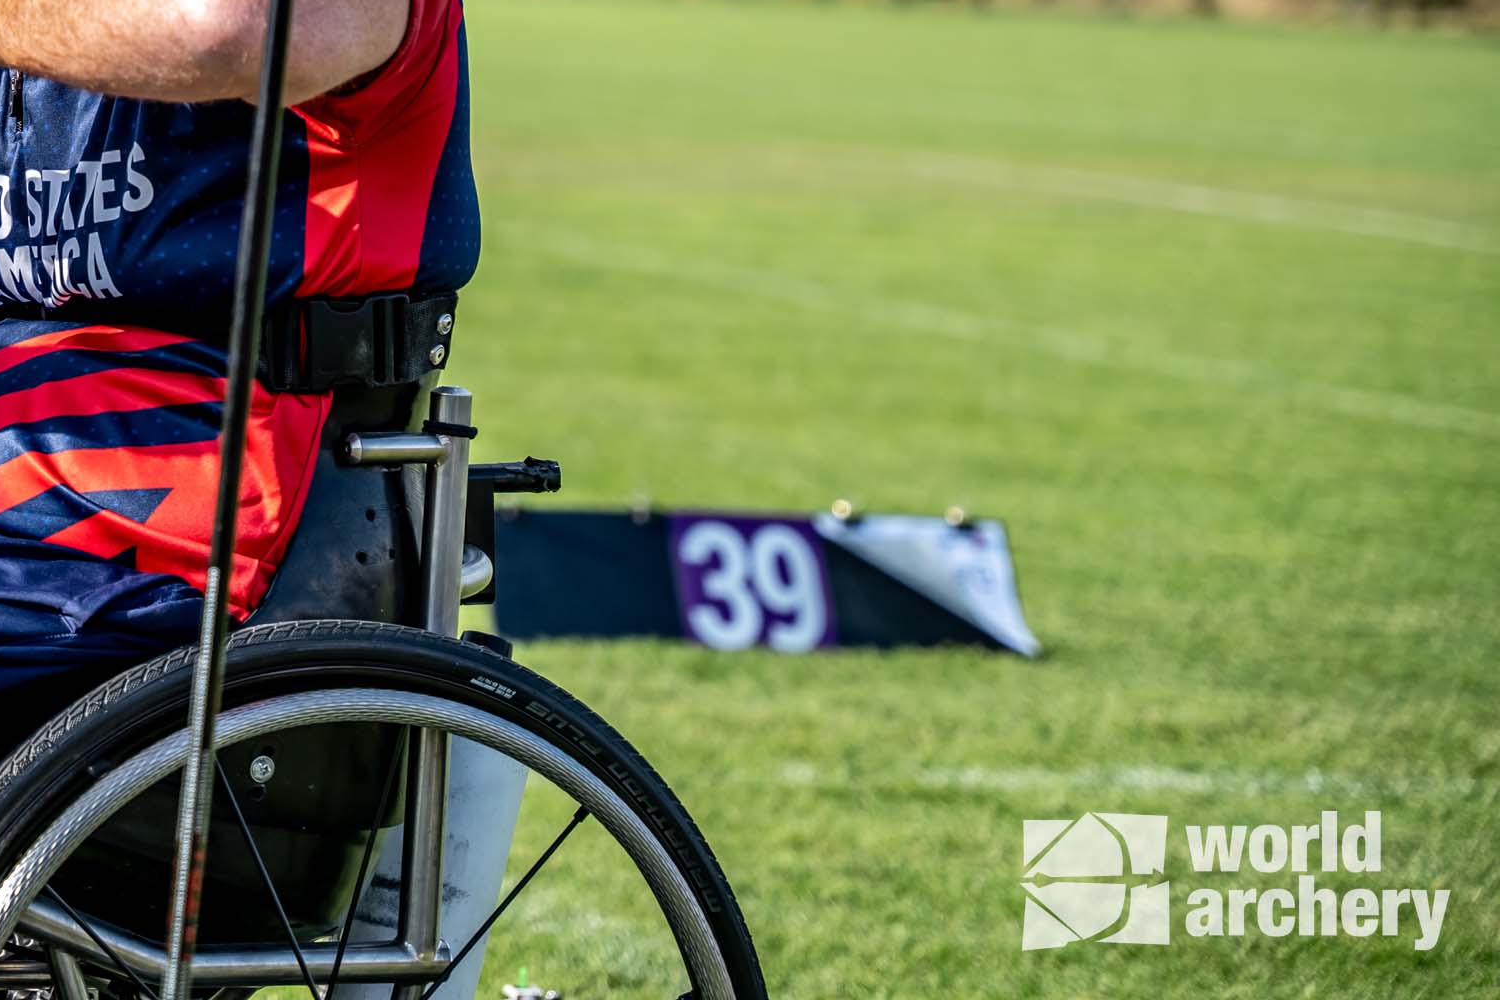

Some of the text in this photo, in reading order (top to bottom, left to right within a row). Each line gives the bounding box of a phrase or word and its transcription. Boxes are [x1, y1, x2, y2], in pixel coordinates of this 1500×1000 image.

[679, 519, 827, 653] 39
[525, 700, 722, 913] MARATHON PLUS
